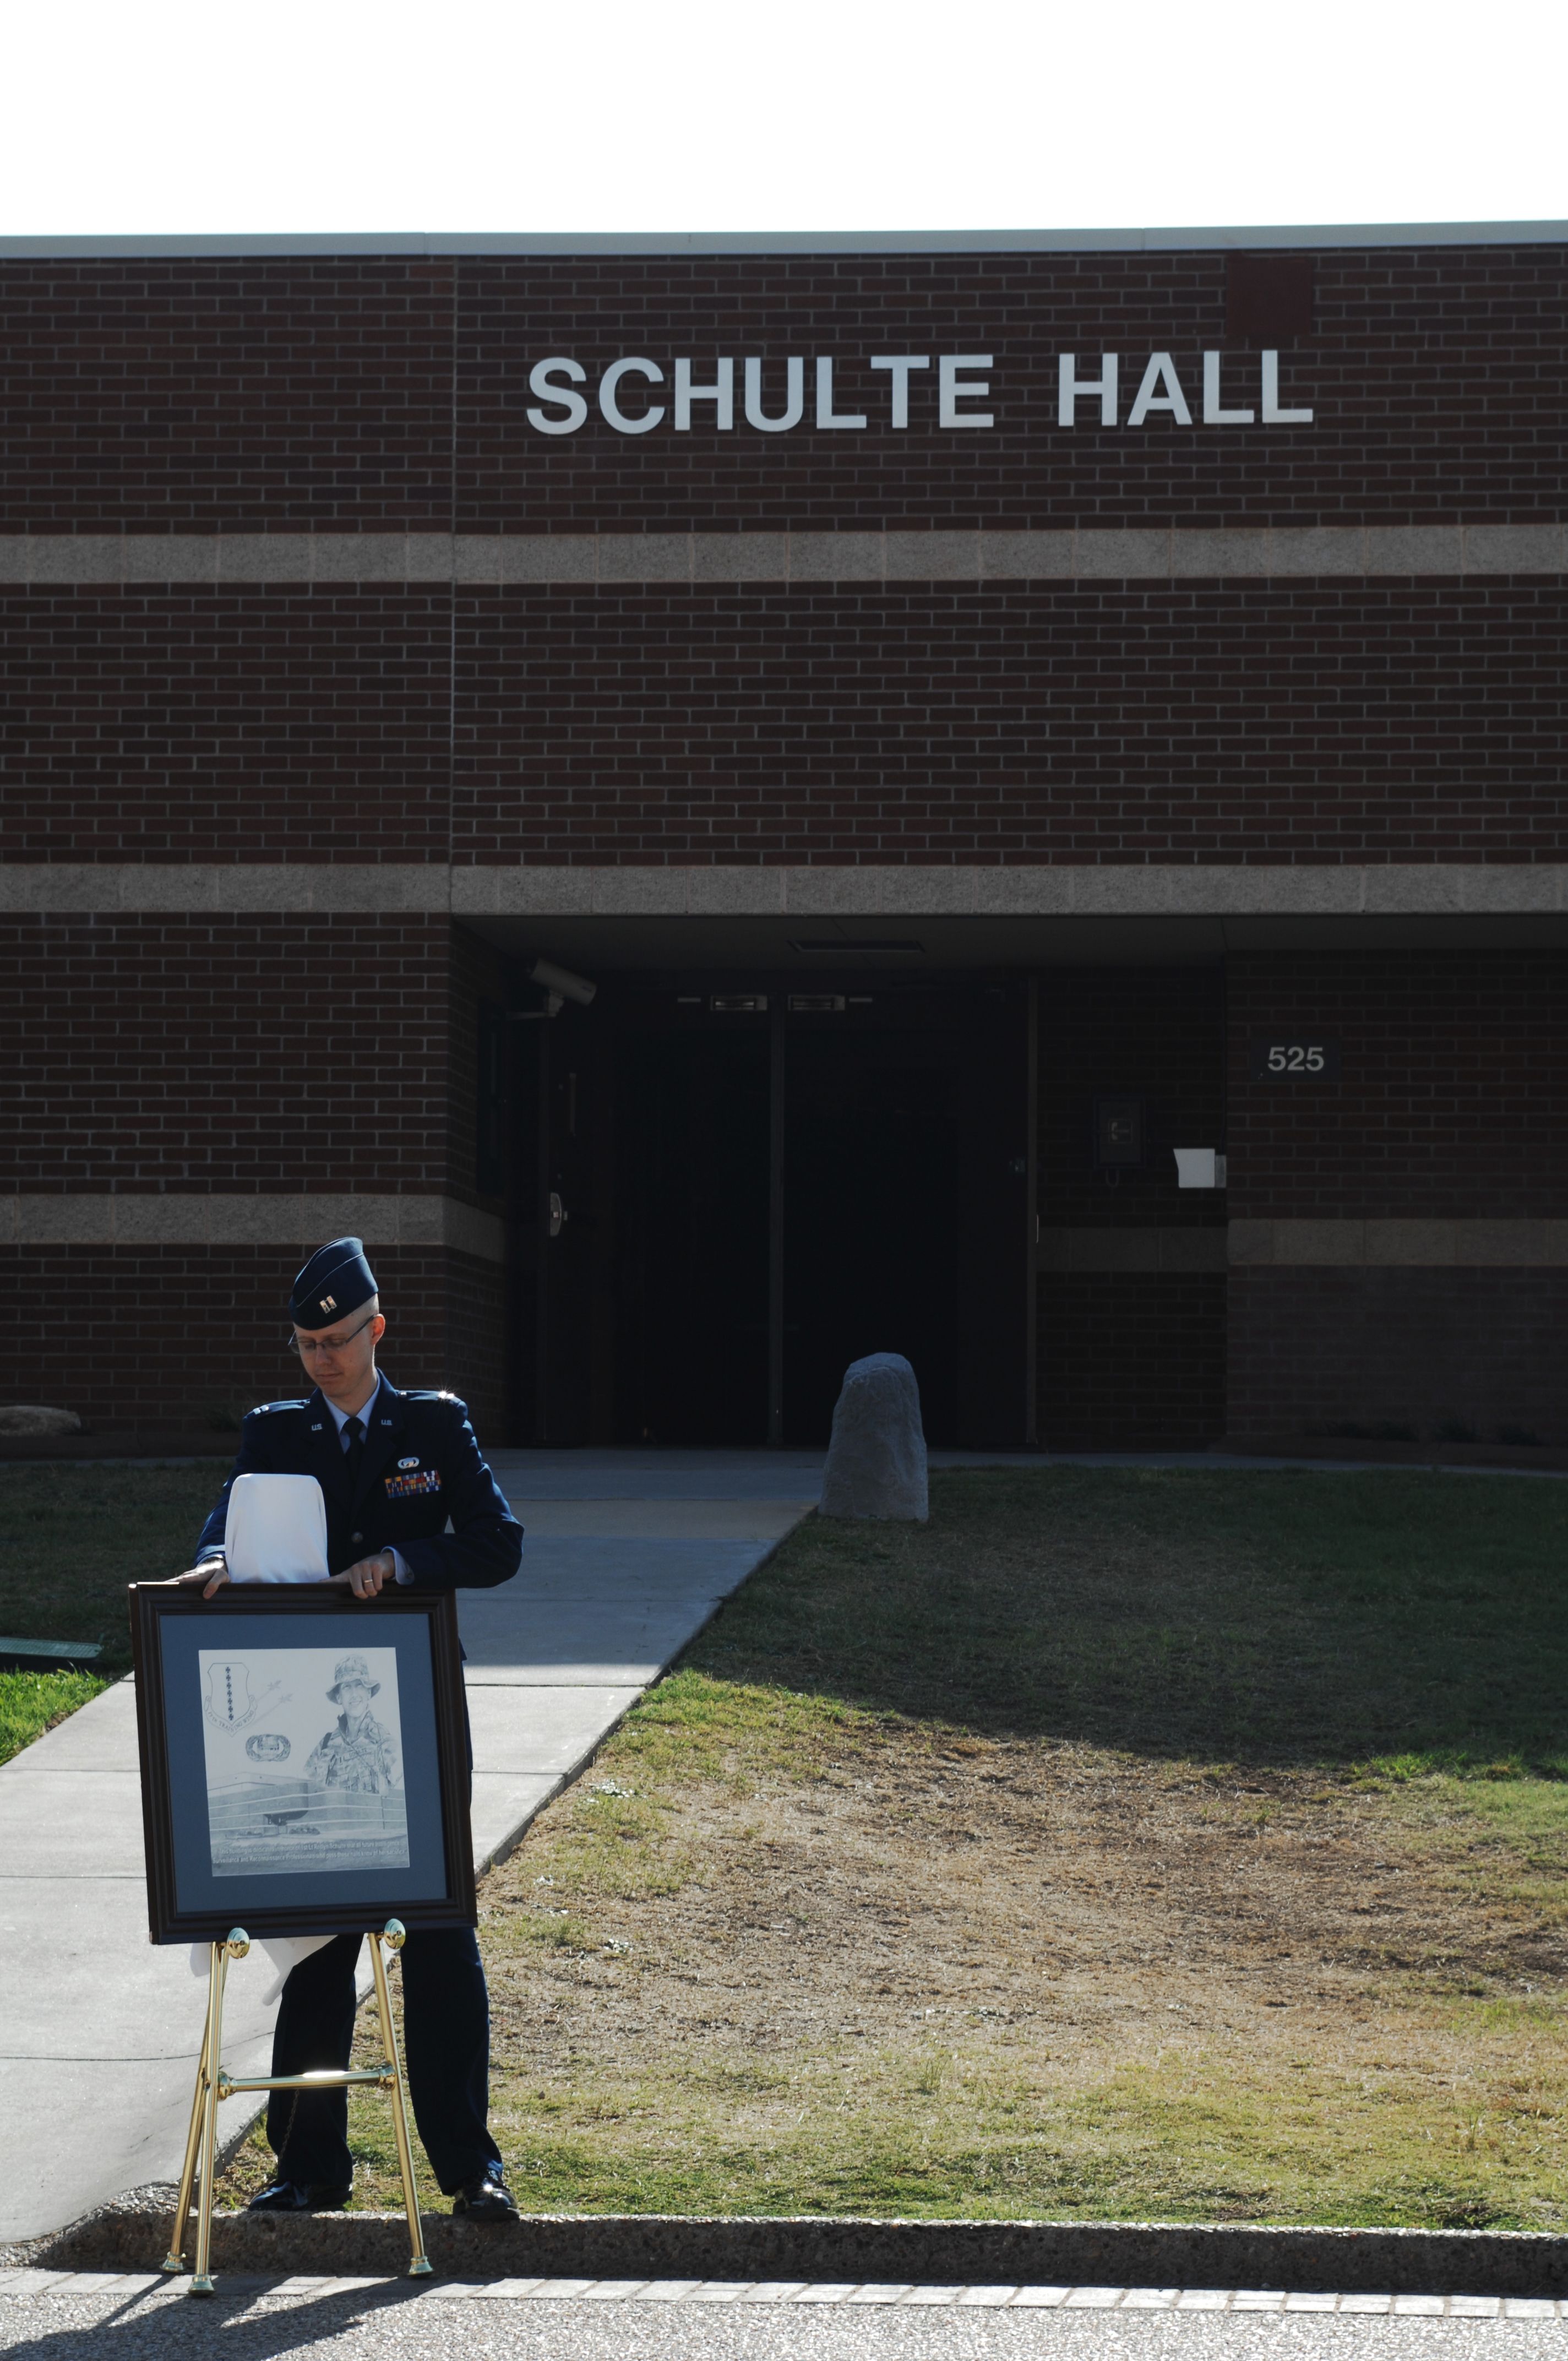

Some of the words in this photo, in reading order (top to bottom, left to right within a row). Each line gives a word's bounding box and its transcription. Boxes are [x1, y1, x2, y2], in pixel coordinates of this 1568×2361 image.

[526, 353, 994, 434] SCHULTE
[1058, 350, 1313, 426] HALL
[1268, 1047, 1324, 1071] 525
[219, 1721, 242, 1732] TRAINING
[242, 1710, 254, 1723] WING
